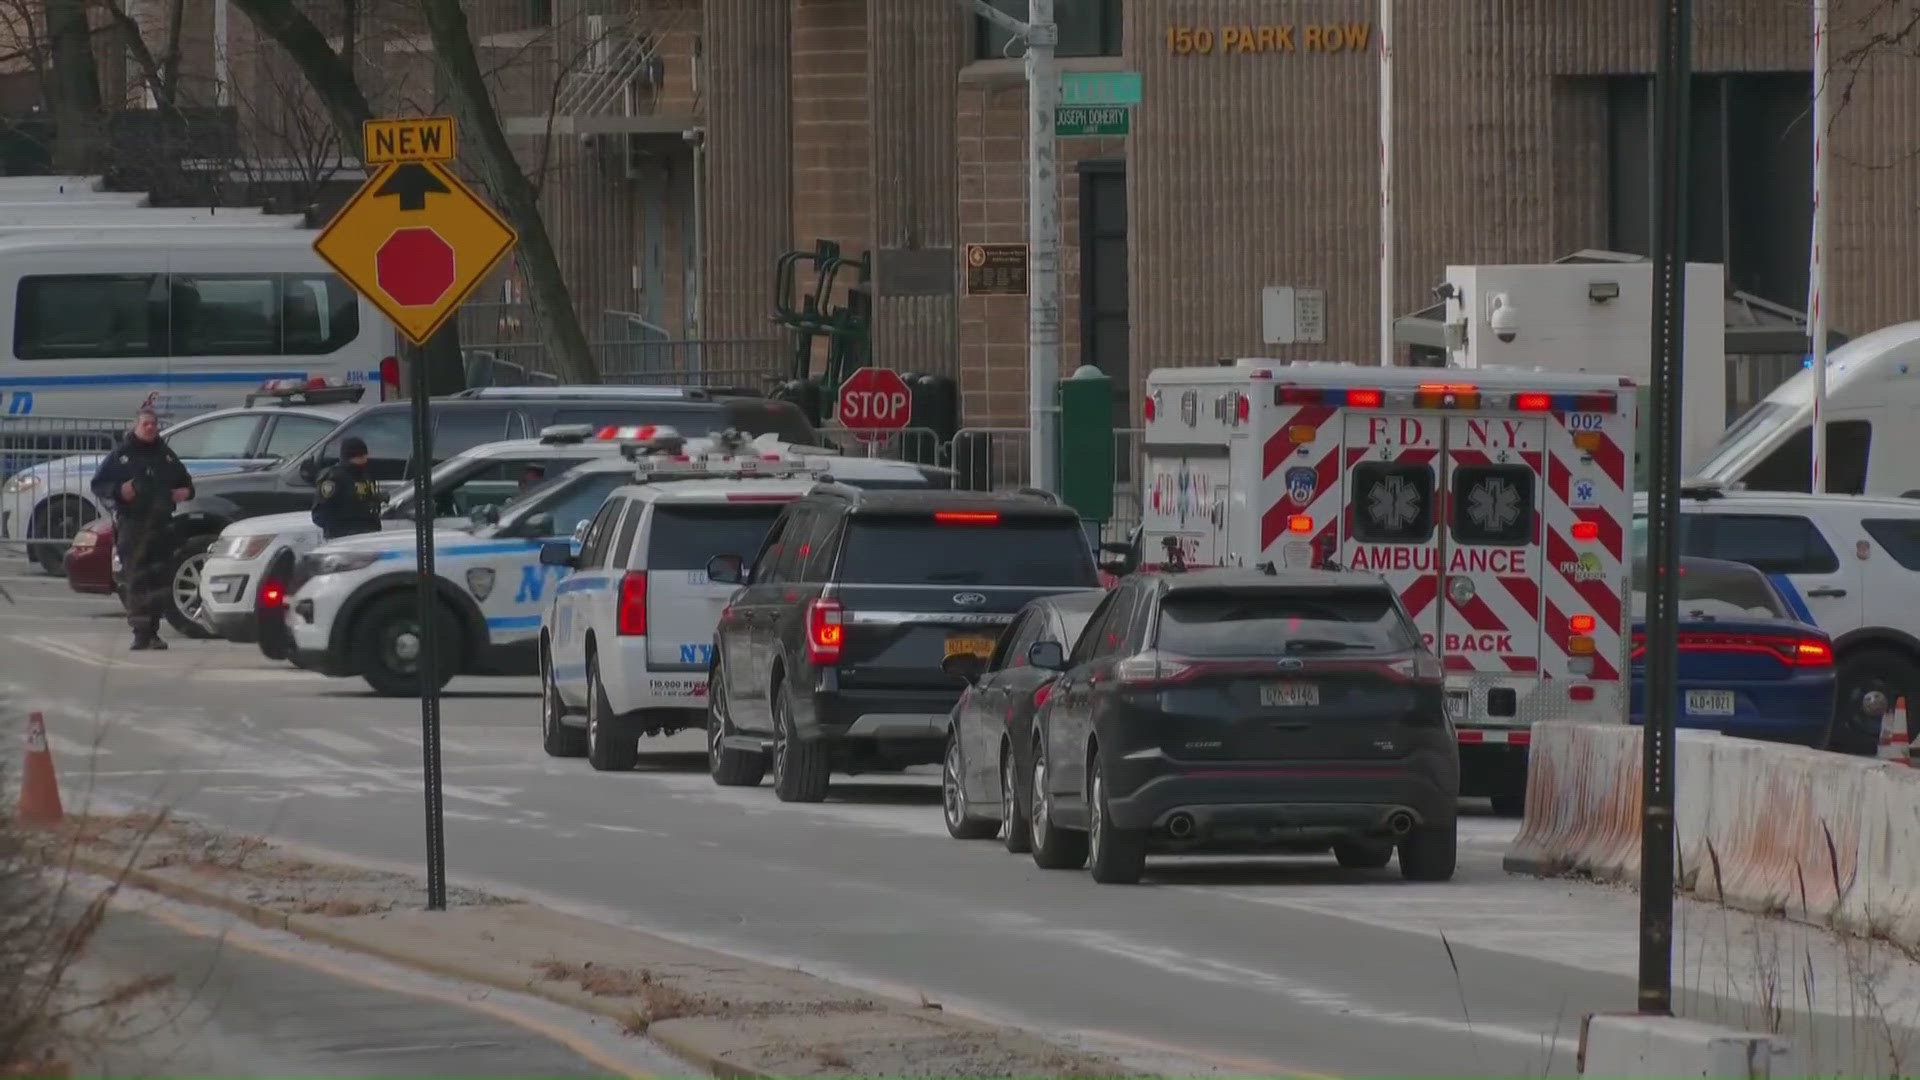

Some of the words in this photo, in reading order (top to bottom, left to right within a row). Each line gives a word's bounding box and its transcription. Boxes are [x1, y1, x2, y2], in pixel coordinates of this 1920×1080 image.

[1166, 24, 1213, 54] 150
[1221, 24, 1295, 52] PARK
[1304, 21, 1370, 52] ROW
[1056, 109, 1087, 126] JOSEPH
[1089, 109, 1125, 125] DOHERTY
[375, 126, 442, 156] NEW
[844, 390, 906, 419] STOP
[1570, 413, 1603, 430] 002
[1350, 545, 1526, 573] AMBULANCE
[1445, 633, 1513, 653] BACK
